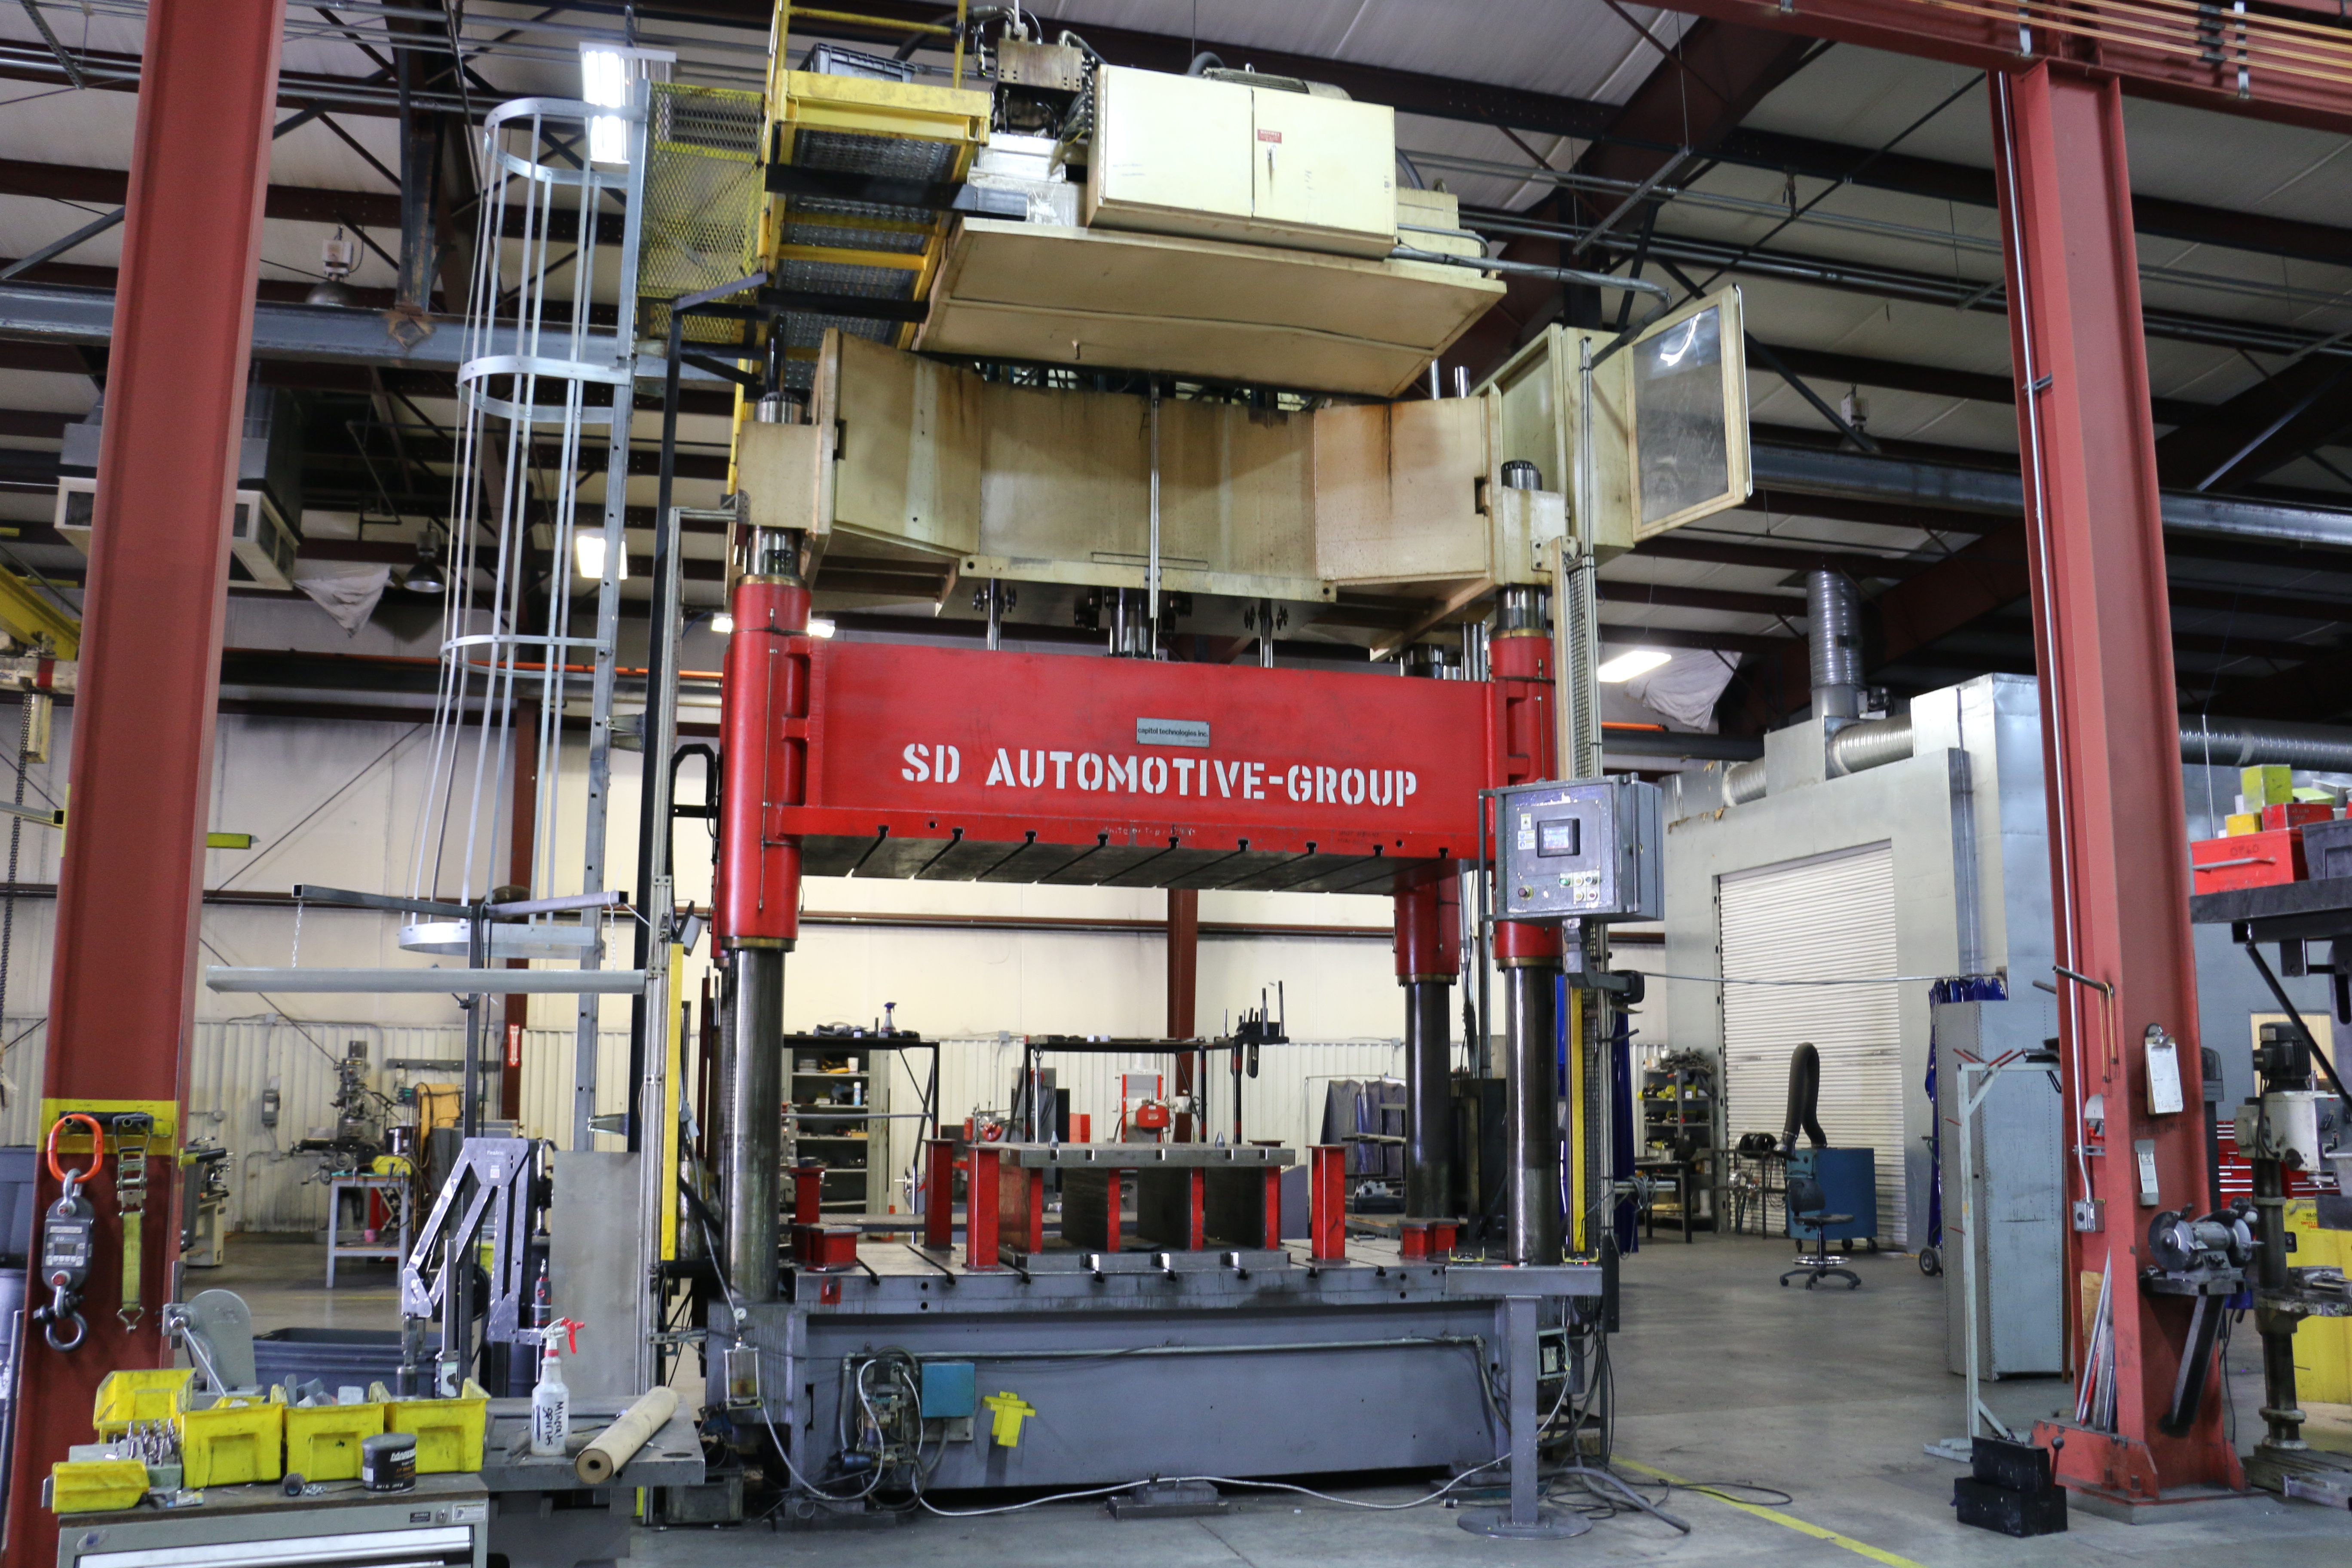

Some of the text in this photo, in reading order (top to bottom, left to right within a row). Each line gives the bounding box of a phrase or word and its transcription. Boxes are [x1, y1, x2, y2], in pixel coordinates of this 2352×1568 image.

[1160, 728, 1197, 737] technologies
[901, 744, 1417, 807] SD AUTOMOTIVE-GROUP
